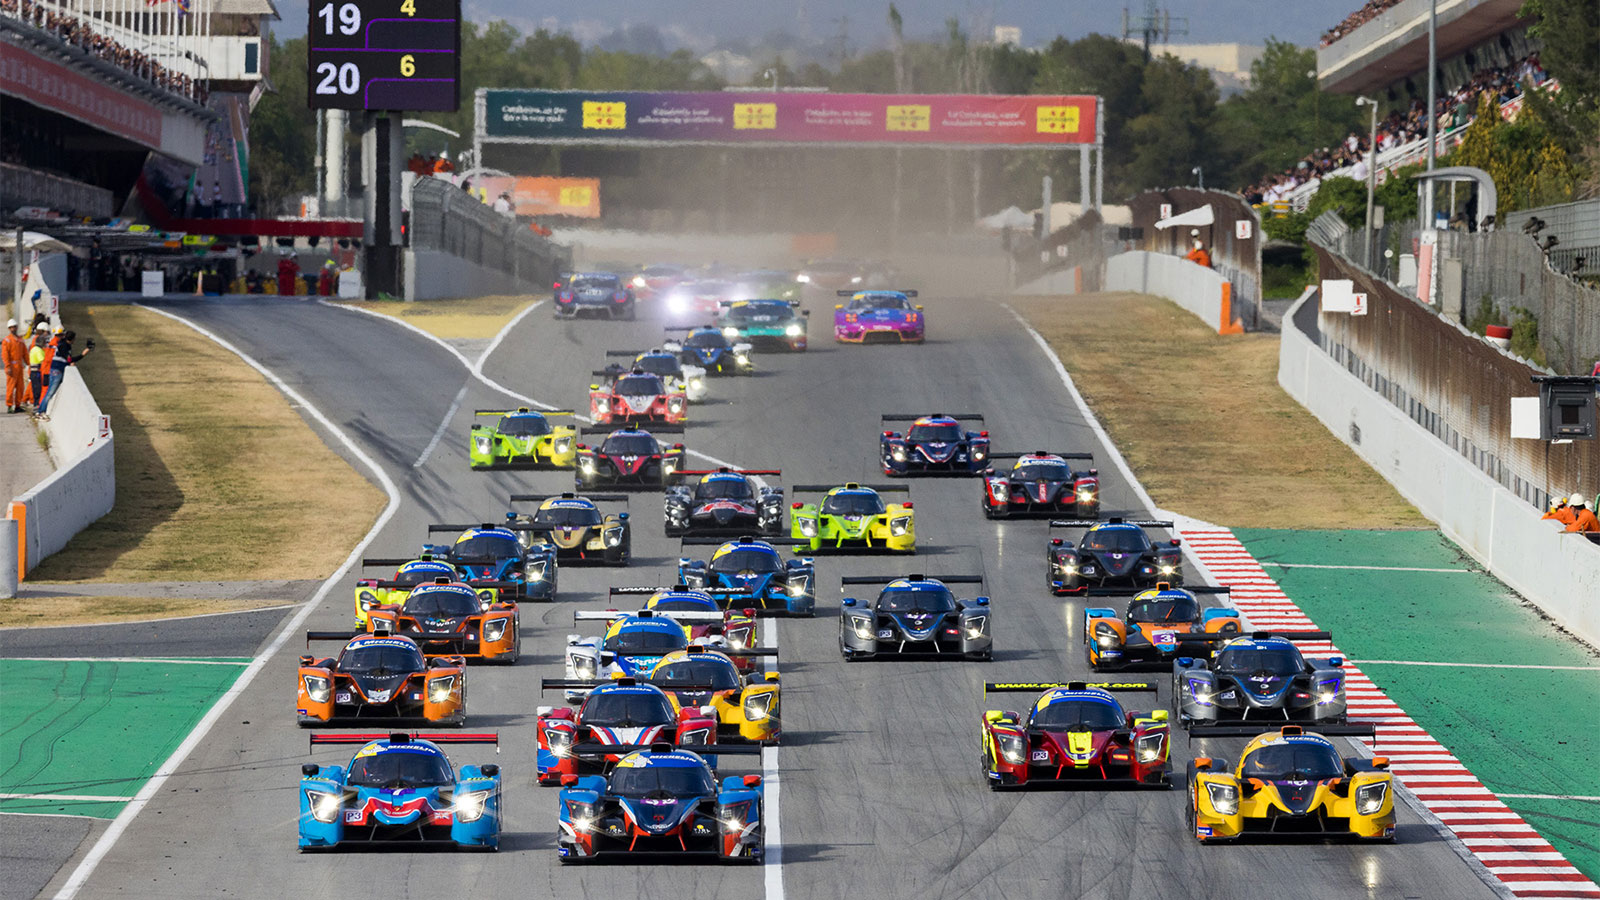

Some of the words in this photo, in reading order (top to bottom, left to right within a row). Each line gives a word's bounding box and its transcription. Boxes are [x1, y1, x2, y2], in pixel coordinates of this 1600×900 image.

[318, 3, 361, 36] 19
[400, 0, 417, 17] 4
[316, 62, 361, 95] 20
[400, 54, 416, 77] 6
[363, 640, 418, 652] MICHELIN
[387, 743, 437, 754] MICHELIN
[649, 754, 698, 763] MICHELIN
[1033, 750, 1048, 760] P3
[346, 812, 362, 822] P3
